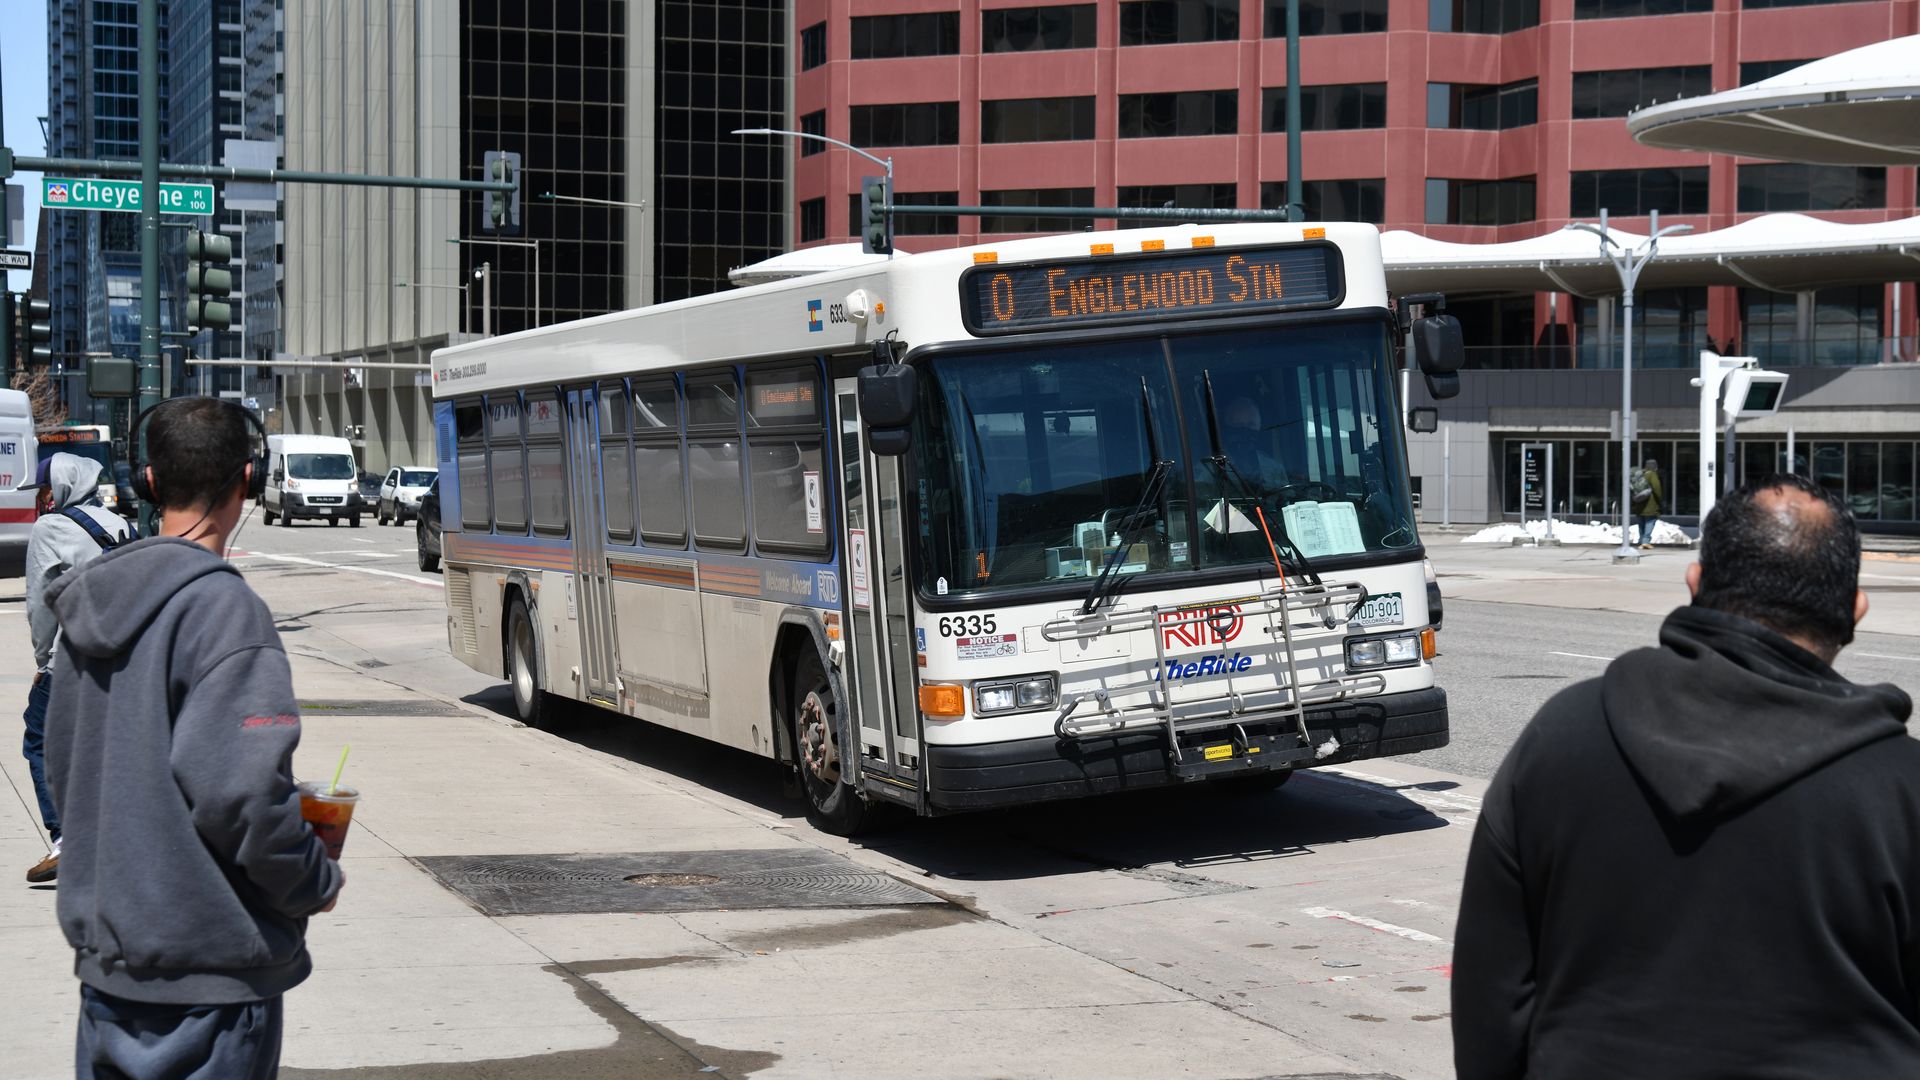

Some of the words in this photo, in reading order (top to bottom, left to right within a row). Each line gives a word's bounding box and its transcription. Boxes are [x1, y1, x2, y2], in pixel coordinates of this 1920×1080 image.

[72, 182, 183, 208] Cheyene
[194, 190, 203, 199] Pl
[190, 200, 206, 209] 100
[11, 256, 26, 264] WAY
[830, 303, 848, 324] 633
[0, 474, 12, 486] 77
[976, 552, 990, 578] 1
[765, 569, 789, 593] Welcome
[791, 573, 812, 596] Aboard
[816, 569, 838, 603] RTD
[939, 613, 997, 638] 6335
[1158, 604, 1244, 650] RTD
[969, 635, 1004, 646] NOTICE
[1155, 652, 1252, 681] TheRide
